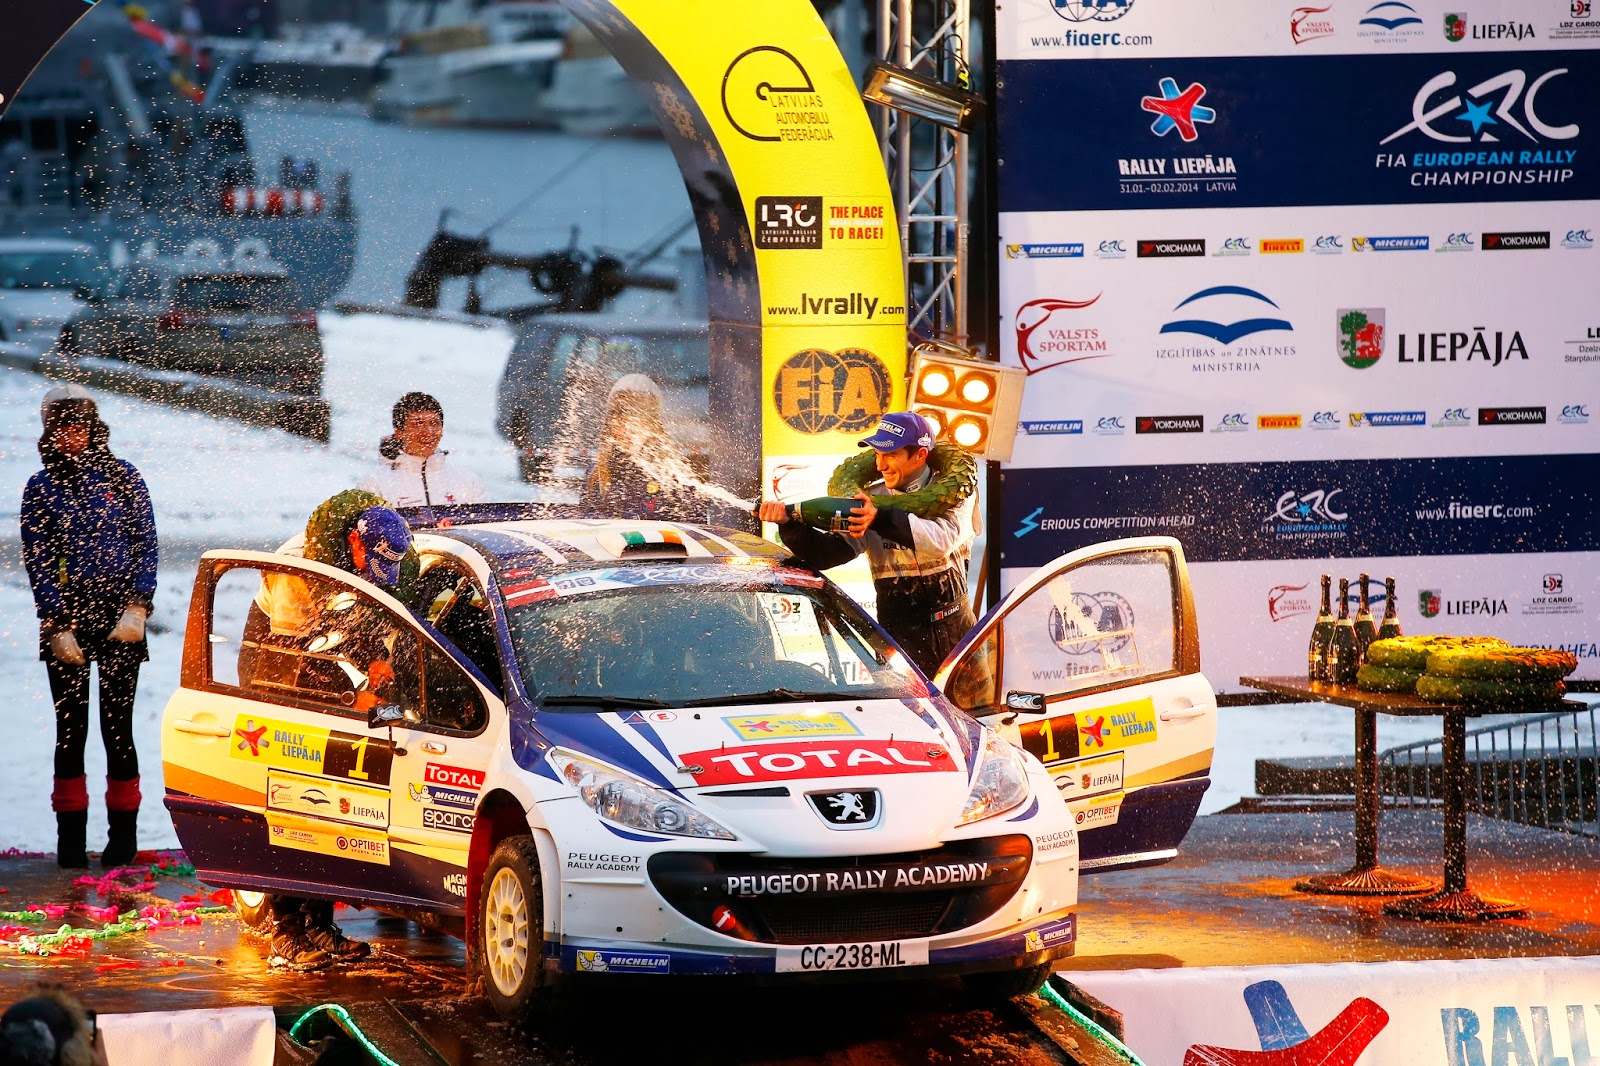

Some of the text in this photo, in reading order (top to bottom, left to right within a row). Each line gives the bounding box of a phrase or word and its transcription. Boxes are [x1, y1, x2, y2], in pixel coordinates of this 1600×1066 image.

[1031, 29, 1152, 47] www.fiaerc.com
[1473, 21, 1535, 41] LIEPĀJA
[769, 95, 823, 108] LATVIJAS
[1379, 68, 1580, 145] ERC
[1118, 155, 1237, 175] RALLY LIEPĀJA
[1376, 150, 1577, 167] FIA EUROPEAN RALLY
[1410, 169, 1574, 186] CHAMPIONSHIP
[1206, 182, 1237, 192] LATVIA
[830, 206, 883, 218] THE PLACE
[830, 228, 883, 239] TO RACE!
[1155, 243, 1203, 253] YOKOHAMA
[1374, 238, 1428, 247] MICHELIN
[1500, 236, 1547, 246] YOKOHAMA
[1029, 246, 1082, 254] MICHELIN
[767, 293, 904, 319] www.lvrally.com
[1049, 328, 1098, 340] VALSTS
[1039, 340, 1107, 353] SPORTAM
[1236, 345, 1297, 357] ZINĀTNES
[1398, 327, 1530, 367] LIEPĀJA
[1192, 363, 1261, 372] MINISTRIJA
[1370, 414, 1424, 423] MICHELIN
[1496, 411, 1543, 421] YOKOHAMA
[1028, 423, 1082, 431] MICHELIN
[1154, 420, 1201, 430] YOKOHAMA
[1415, 502, 1533, 520] www.fiaerc.com
[1083, 517, 1156, 530] COMPETITION
[1158, 515, 1195, 527] AHEAD
[1322, 523, 1347, 531] RALLY
[1447, 597, 1509, 616] LIEPĀJA
[1111, 711, 1137, 727] RALLY
[1121, 720, 1155, 737] LIEPĀJA
[274, 729, 305, 746] RALLY
[1038, 719, 1060, 762] 1
[282, 745, 322, 763] LIEPĀJA
[348, 736, 369, 780] 1
[711, 748, 931, 777] TOTAL
[427, 765, 482, 787] TOTAL
[1093, 774, 1119, 787] LIEPĀJA
[435, 791, 475, 804] MICHELI
[353, 806, 385, 820] LIEPĀJA
[1087, 805, 1117, 818] OPTIBET
[1036, 829, 1074, 844] PEUGEOT
[350, 838, 385, 853] OPTIBET
[1038, 839, 1076, 852] RALLY ACADEMY
[568, 852, 641, 864] PEUGEOT
[567, 861, 640, 872] RALLY ACADEMY
[728, 863, 988, 895] PEUGEOT RALLY ACADEMY
[1043, 927, 1071, 941] MICHELIN
[610, 956, 668, 967] MICHELIN
[800, 942, 906, 970] CC-238-ML
